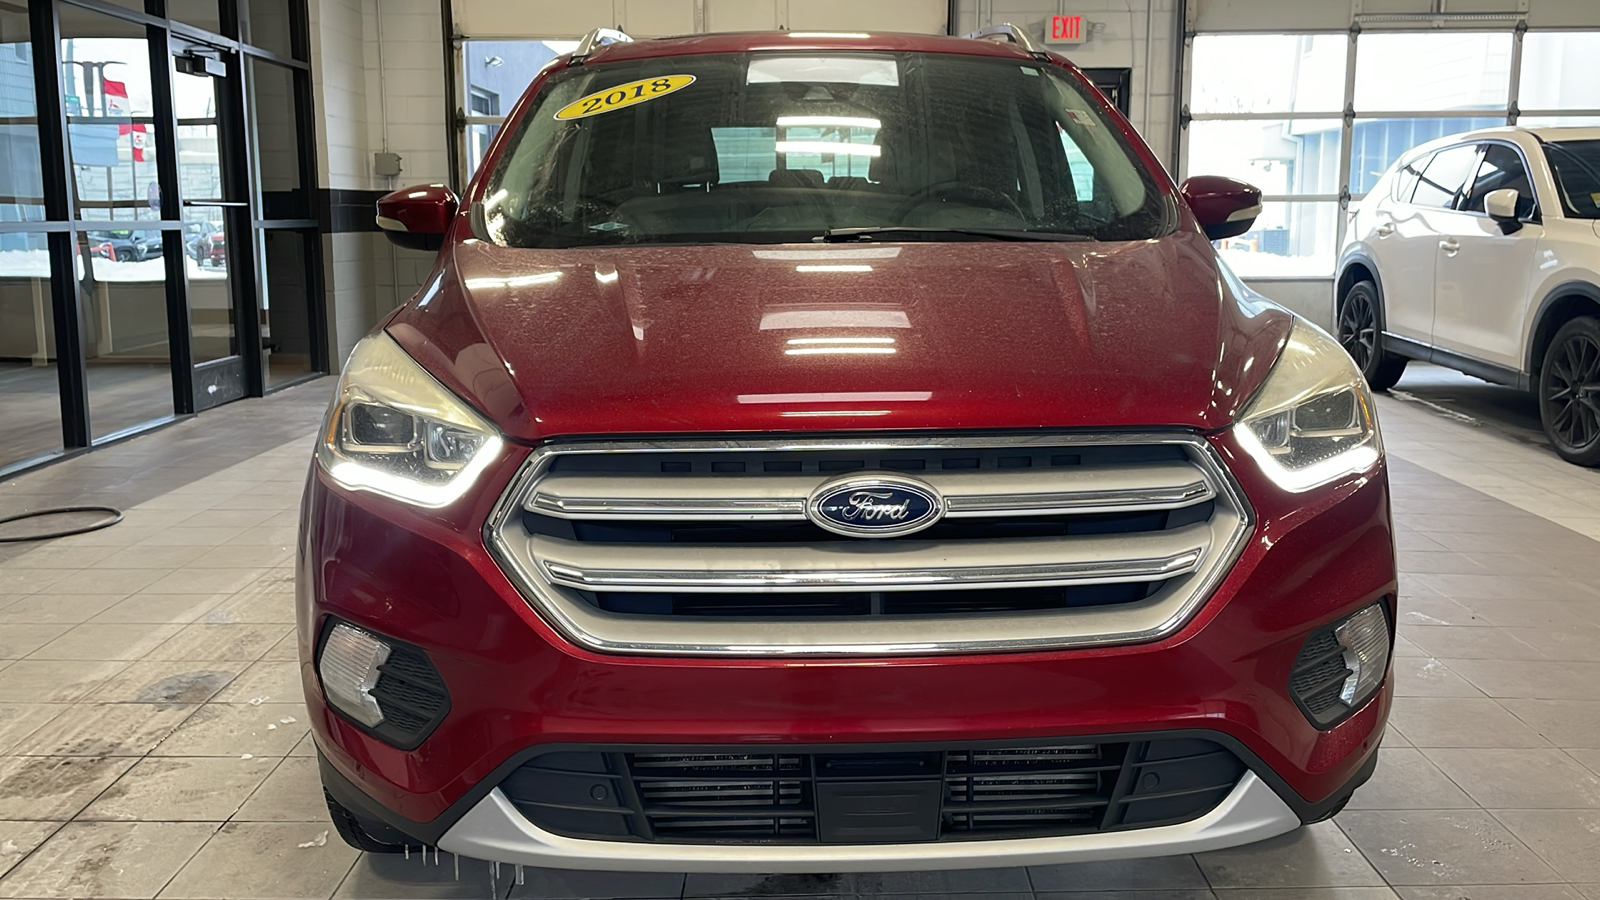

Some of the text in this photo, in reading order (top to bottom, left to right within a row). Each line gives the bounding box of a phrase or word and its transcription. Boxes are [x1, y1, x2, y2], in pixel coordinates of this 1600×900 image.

[1052, 15, 1082, 39] EXIT
[582, 78, 671, 114] 2018
[842, 491, 910, 520] Ford
